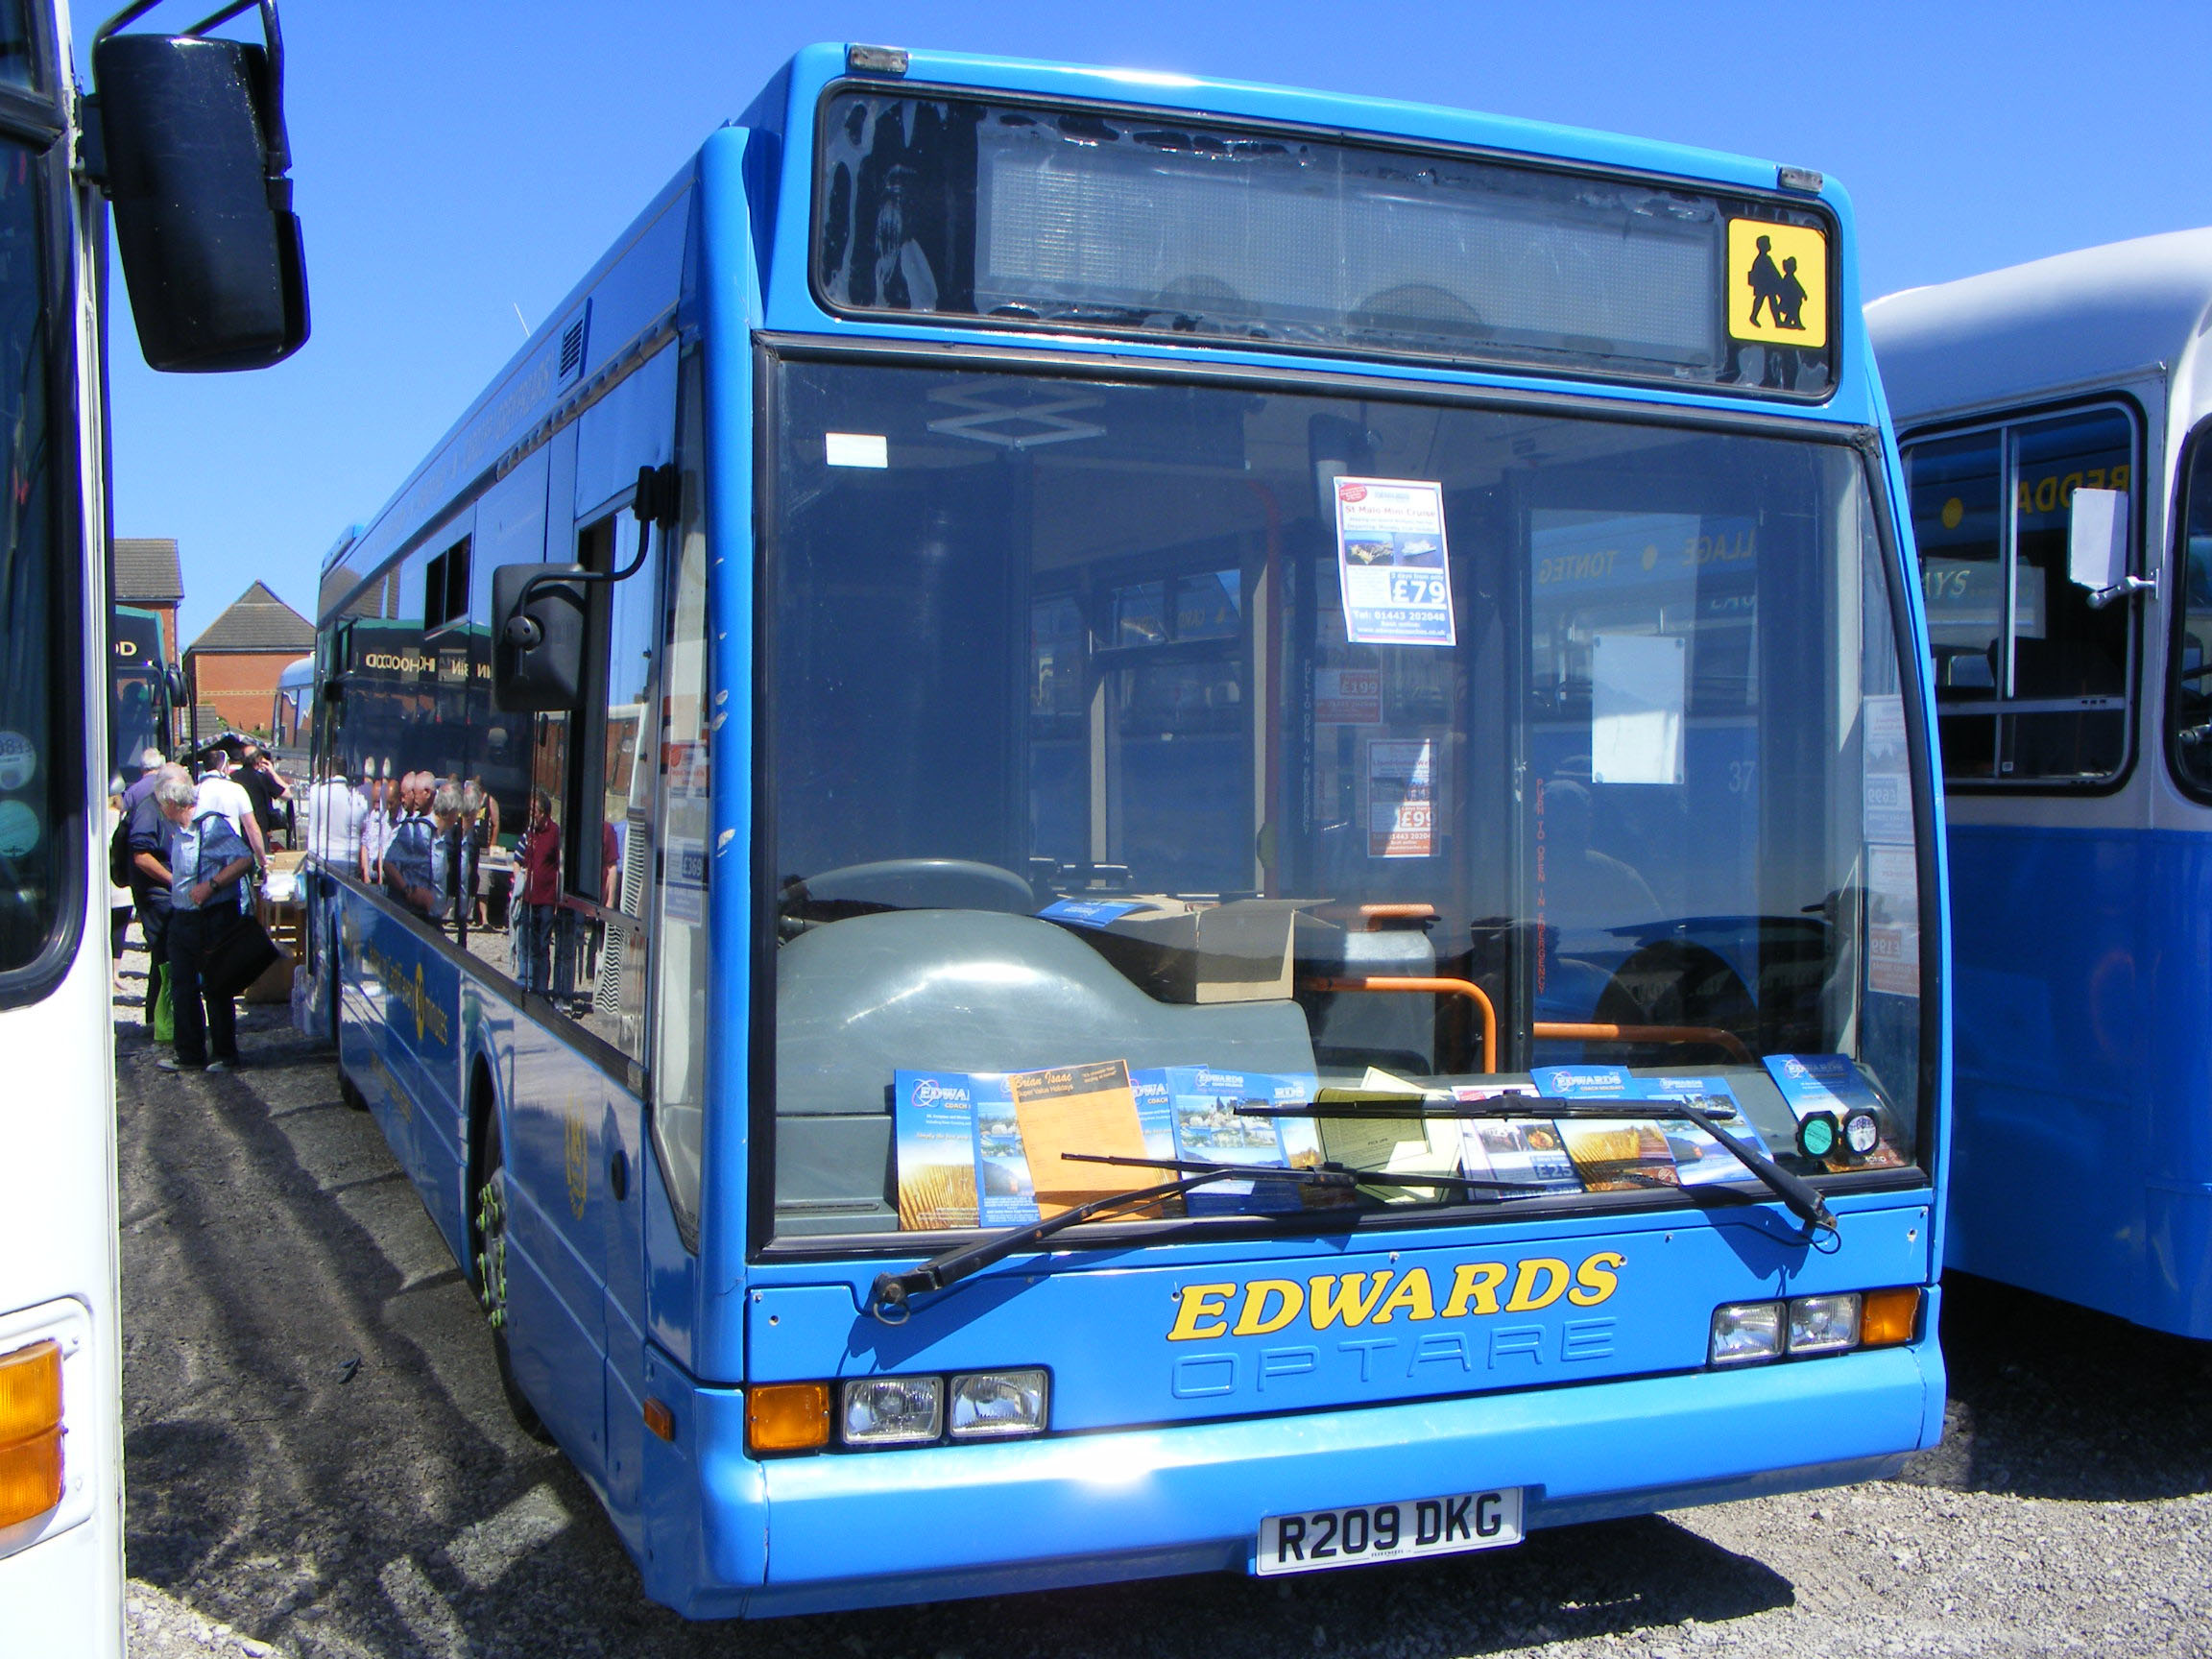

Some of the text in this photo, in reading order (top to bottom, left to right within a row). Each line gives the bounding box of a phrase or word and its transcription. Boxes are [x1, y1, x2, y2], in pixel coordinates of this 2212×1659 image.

[1392, 580, 1446, 603] £79
[1728, 761, 1757, 792] 37
[920, 1086, 970, 1101] EDWA
[1557, 1074, 1623, 1087] EDWARDS
[1537, 1165, 1574, 1178] £25
[1166, 1251, 1624, 1342] EDWARDS
[1171, 1316, 1618, 1400] OPTARE
[1278, 1493, 1503, 1564] R209 DKG
